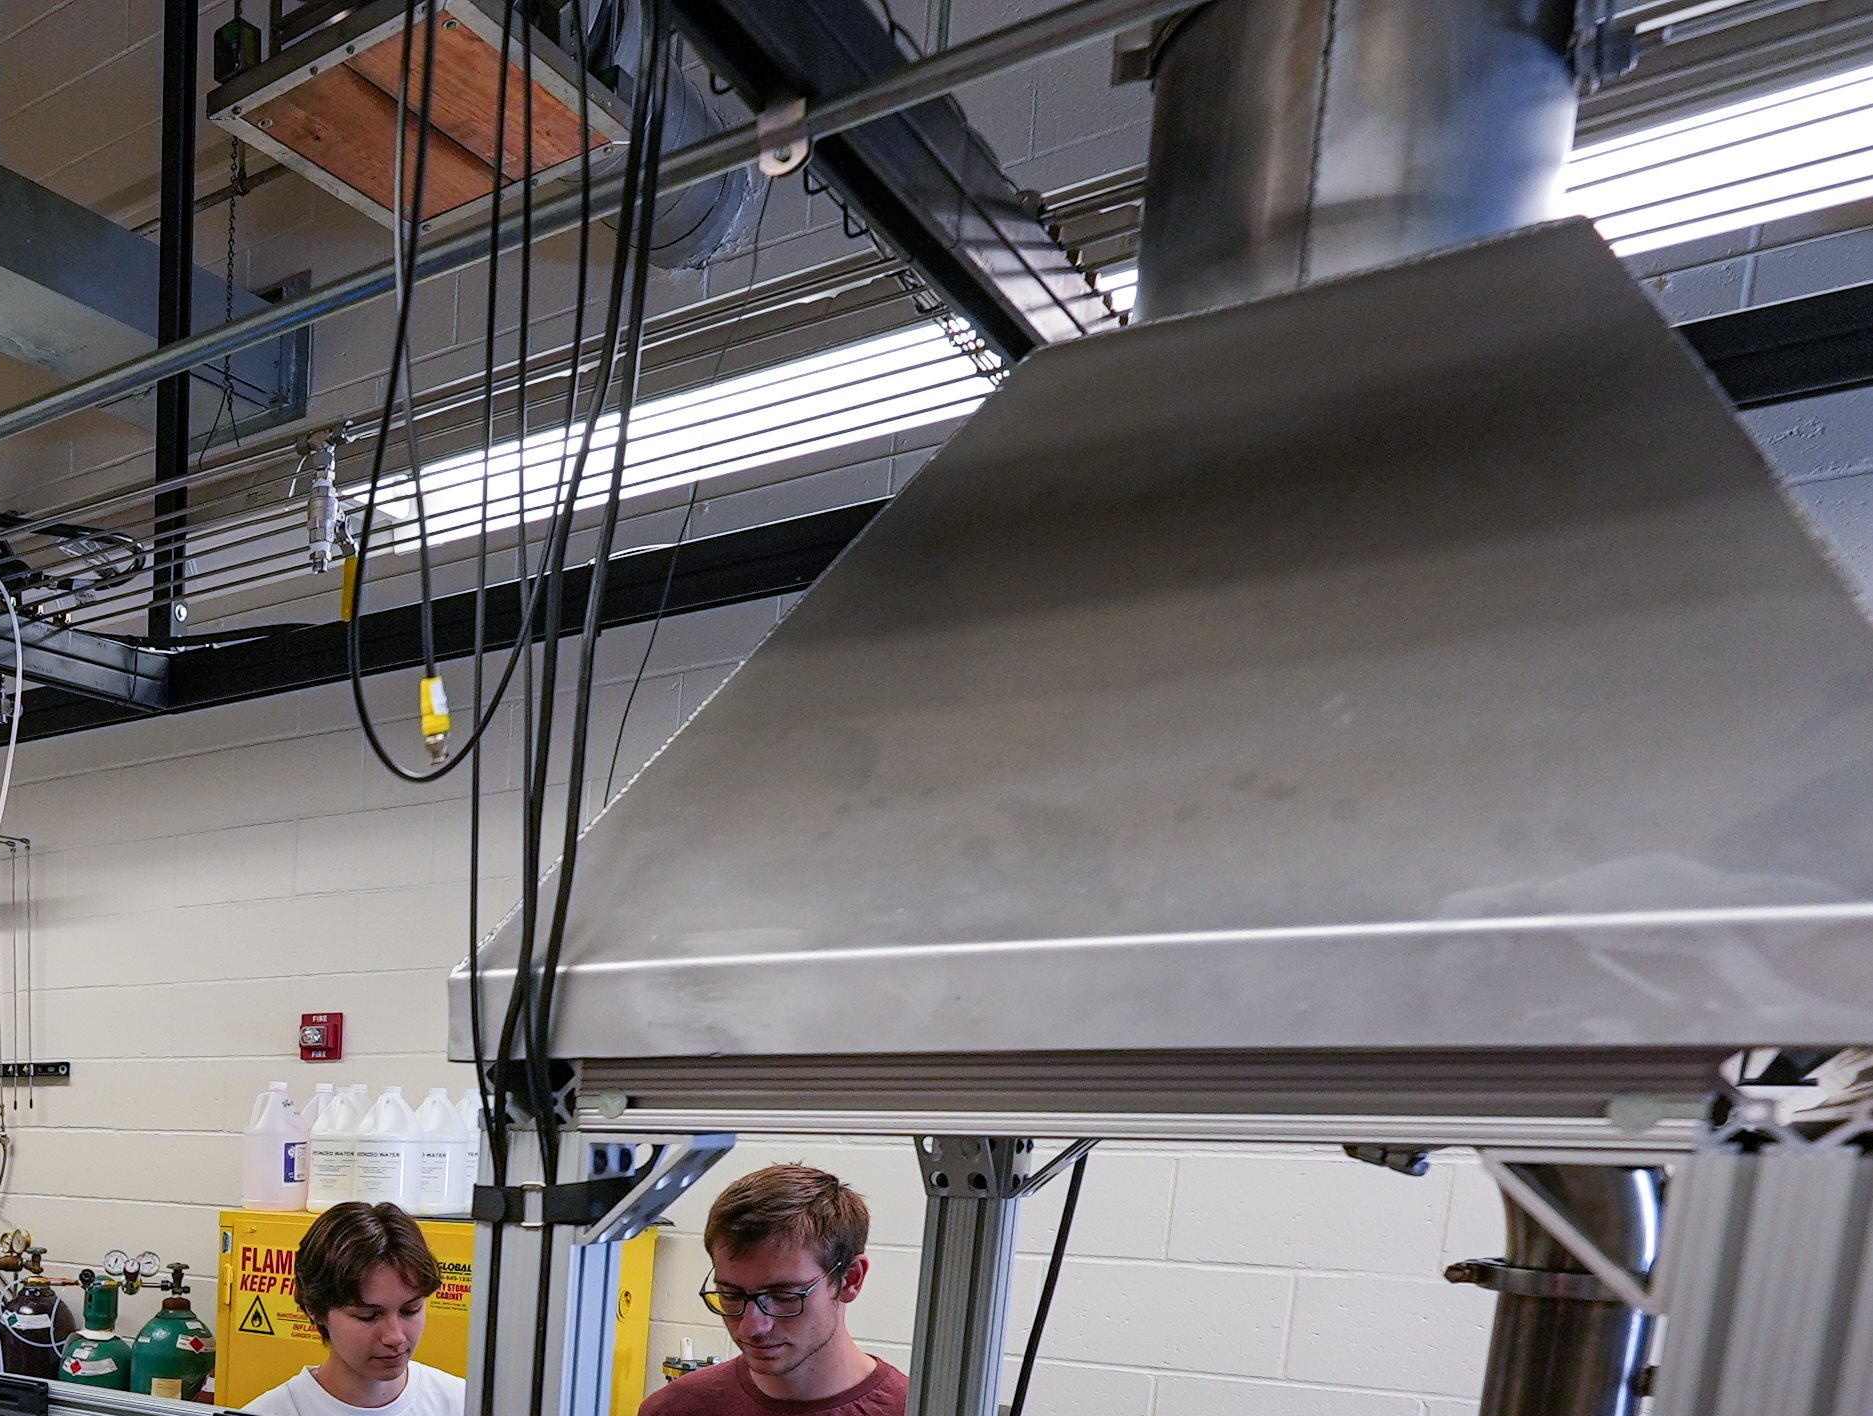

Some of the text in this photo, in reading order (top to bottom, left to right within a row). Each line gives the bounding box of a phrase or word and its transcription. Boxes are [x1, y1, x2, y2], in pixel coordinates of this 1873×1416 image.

[241, 1247, 298, 1275] FLAM
[240, 1273, 296, 1295] KEEP FI
[435, 1291, 463, 1301] CABINET
